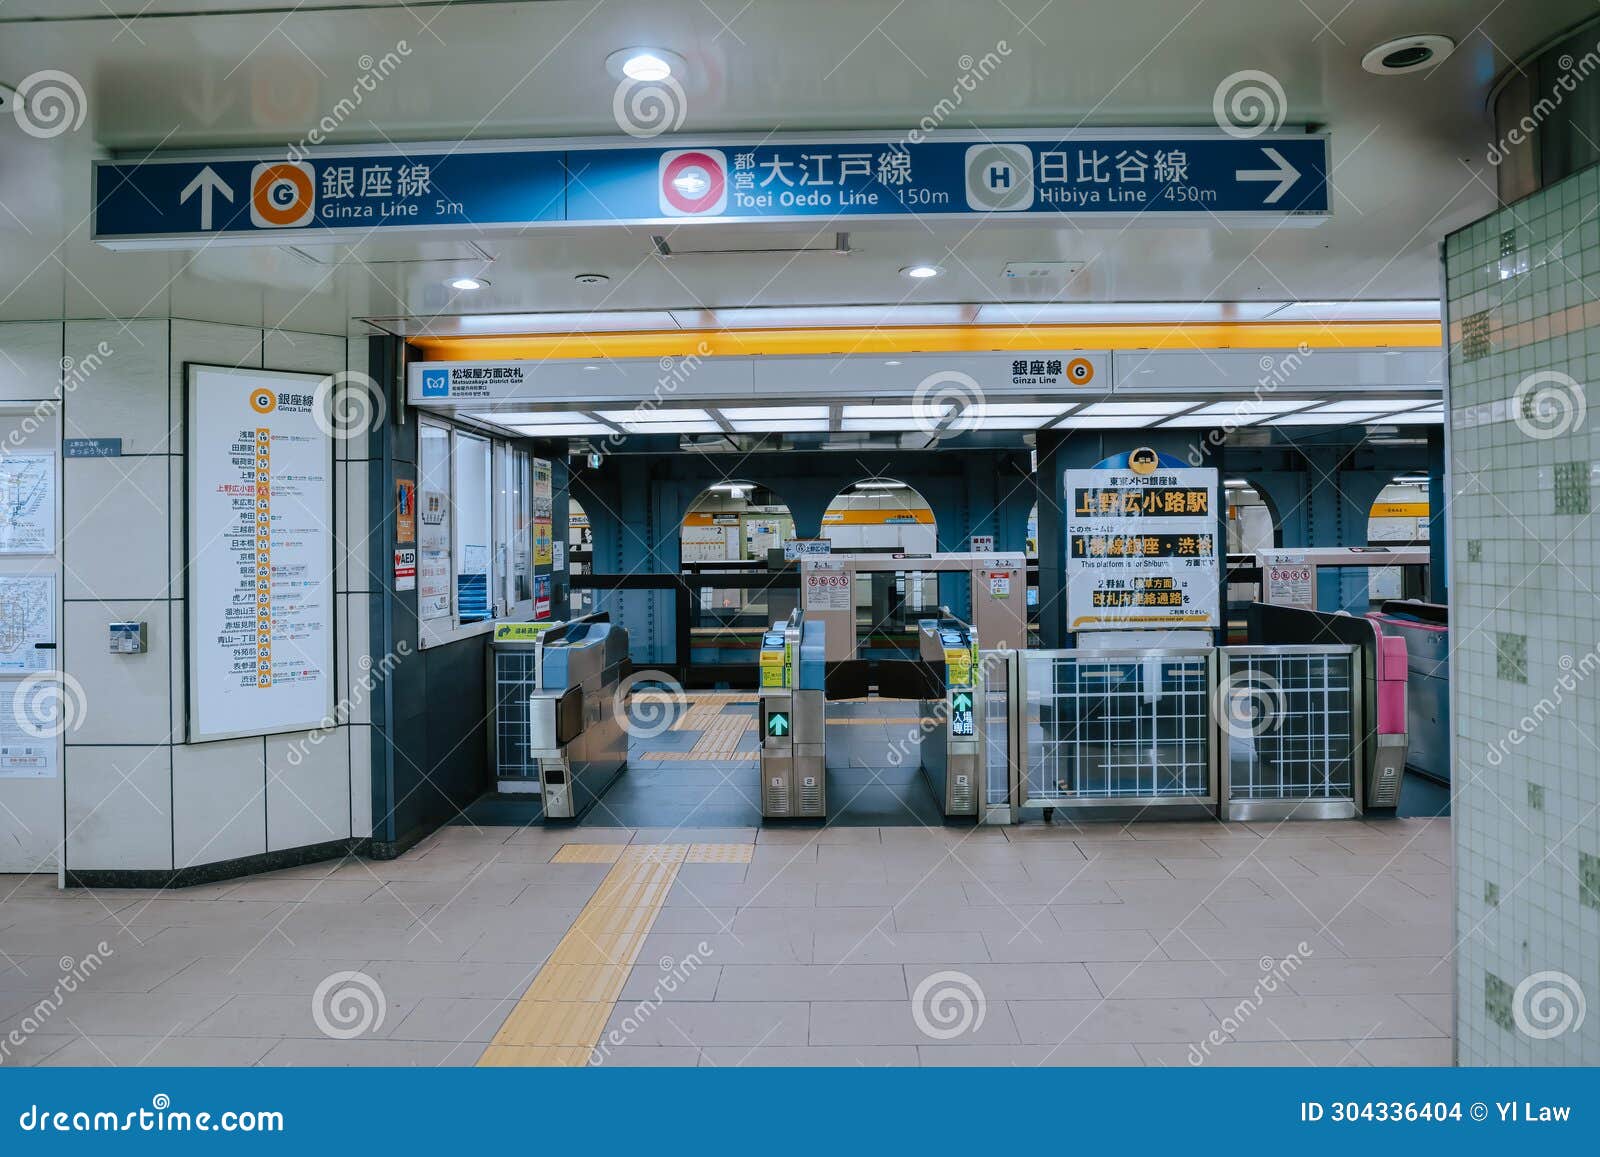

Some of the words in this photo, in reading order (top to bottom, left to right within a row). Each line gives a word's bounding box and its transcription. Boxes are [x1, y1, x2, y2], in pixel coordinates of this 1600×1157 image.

[759, 153, 912, 187] 大江戸線
[1041, 150, 1188, 183] 日比谷線
[321, 165, 431, 199] 銀座線
[990, 167, 1010, 188] H
[273, 183, 296, 205] G
[734, 190, 775, 206] Toei
[780, 189, 832, 206] Oedo
[839, 188, 879, 205] Line
[898, 188, 950, 205] 150m
[1040, 187, 1101, 206] Hibiya
[1108, 186, 1147, 203] Line
[1165, 186, 1218, 202] 450m
[321, 203, 373, 218] Ginza
[379, 200, 418, 216] Line
[435, 200, 464, 215] 5m
[452, 368, 523, 378] 松坂屋方面改札
[1012, 360, 1062, 375] 銀座線
[1075, 367, 1085, 376] G
[1039, 376, 1056, 384] Line
[258, 396, 268, 406] G
[278, 393, 314, 406] 銀座線
[1076, 491, 1208, 513] 上野広小路駅
[401, 553, 414, 564] AED
